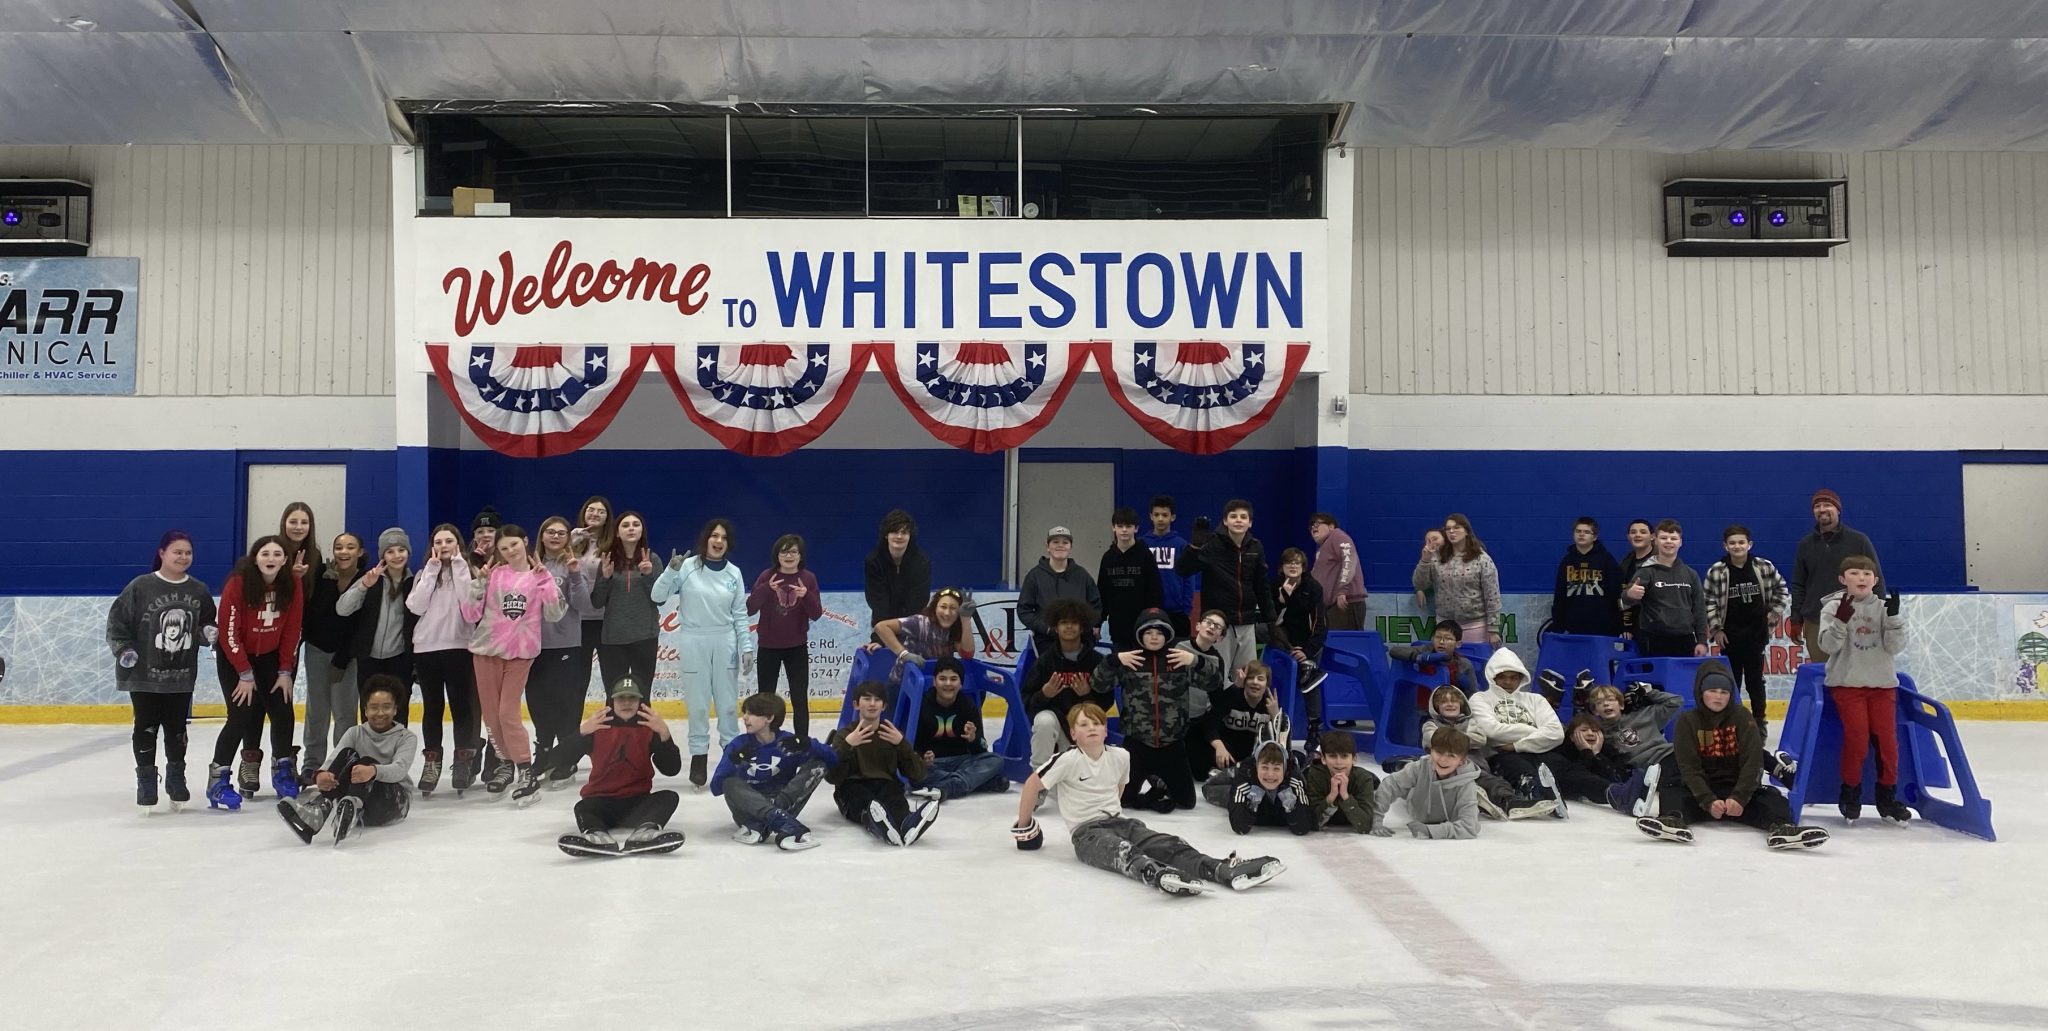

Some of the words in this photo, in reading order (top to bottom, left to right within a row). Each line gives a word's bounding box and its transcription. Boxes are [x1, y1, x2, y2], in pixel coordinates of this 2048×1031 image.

[442, 240, 711, 337] Welcome
[722, 298, 756, 328] TO
[766, 251, 1303, 329] WHITESTOWN
[33, 371, 40, 379] &
[44, 371, 74, 379] HVAC
[77, 371, 118, 379] Service
[820, 639, 838, 649] Rd.
[622, 679, 633, 688] H
[1226, 714, 1265, 728] adid
